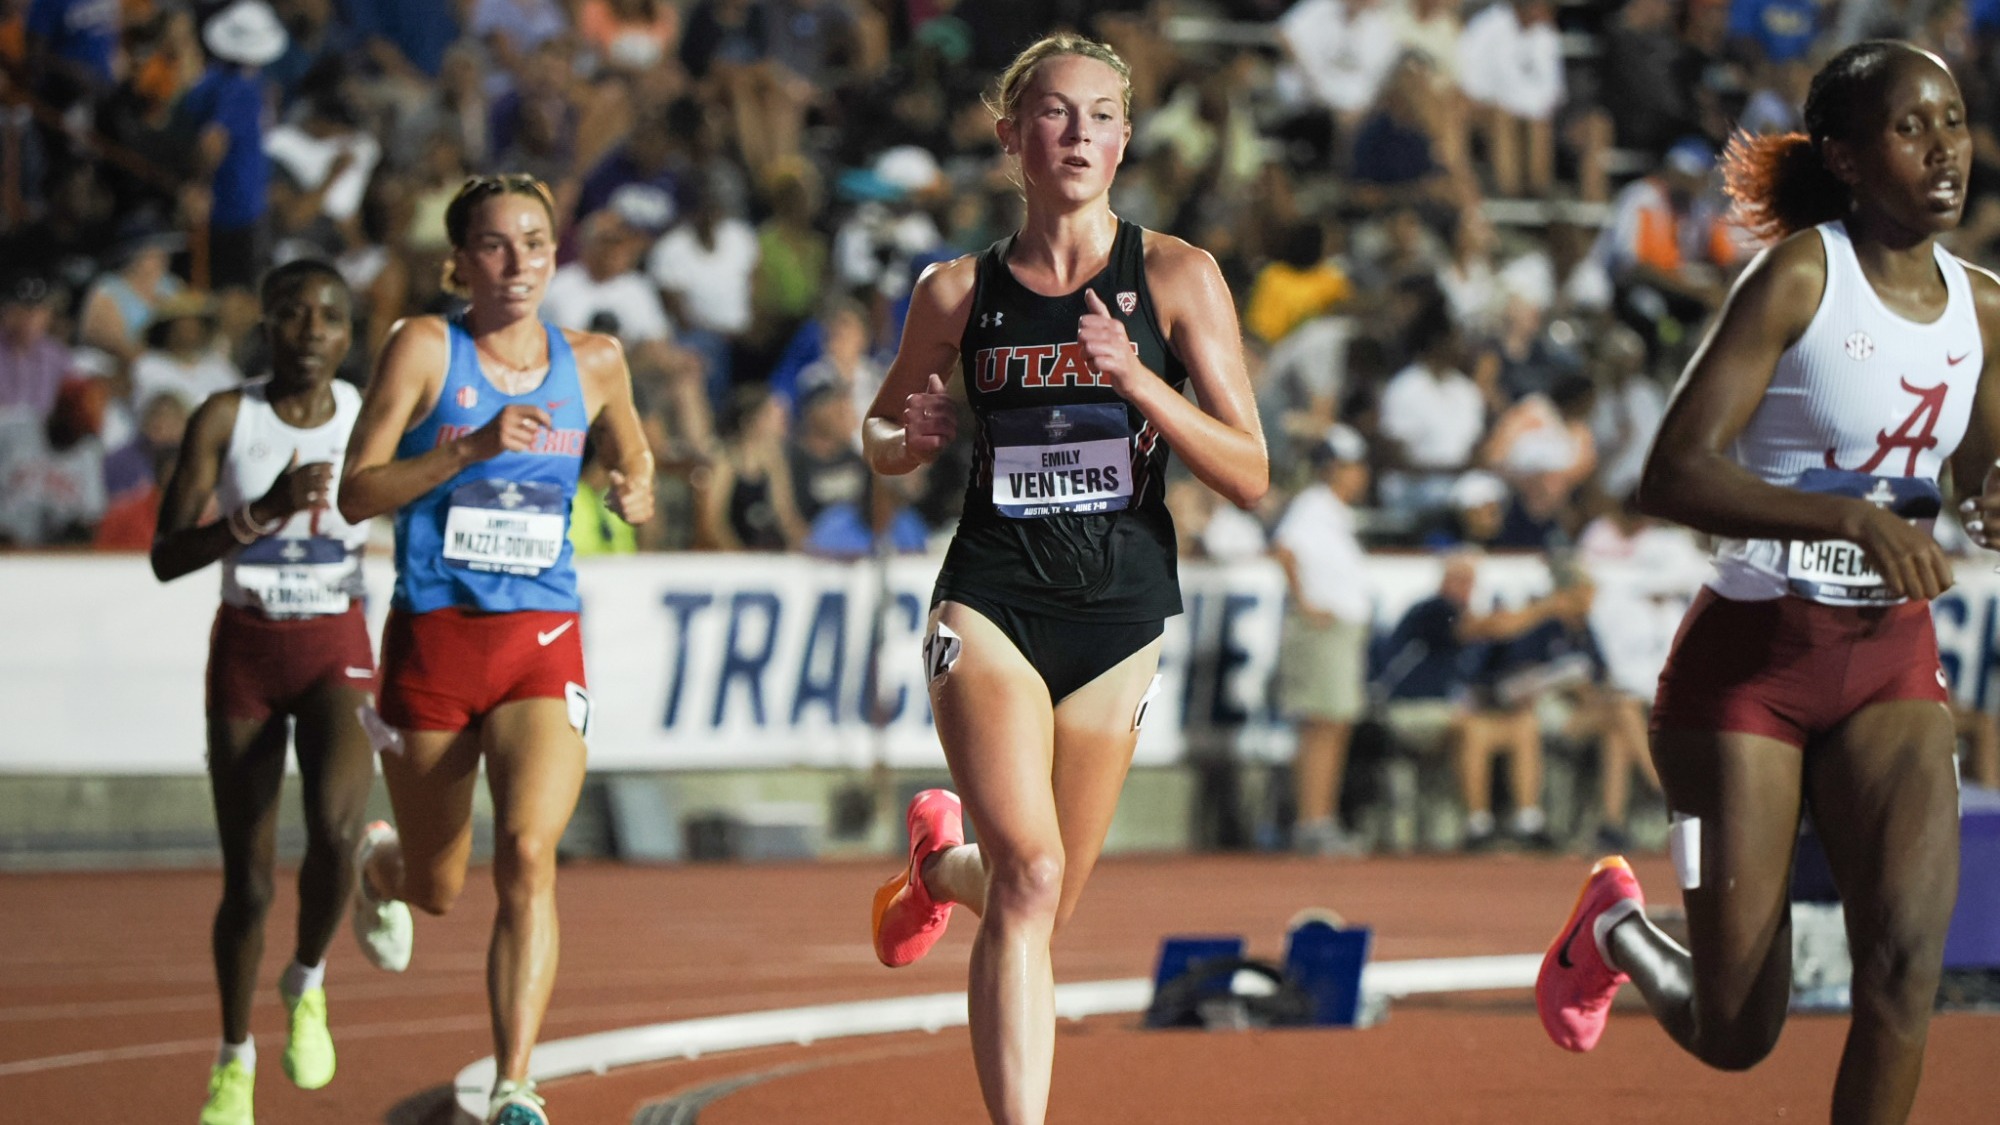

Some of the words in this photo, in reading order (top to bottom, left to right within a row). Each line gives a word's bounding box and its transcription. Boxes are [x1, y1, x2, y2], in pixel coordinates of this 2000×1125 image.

[1121, 302, 1134, 312] 12
[975, 341, 1138, 393] UTA
[1041, 450, 1081, 468] EMILY
[1009, 465, 1120, 499] VENTERS
[1023, 507, 1050, 516] AUSTIN,
[1051, 506, 1061, 514] TX
[1073, 503, 1092, 512] JUNE
[663, 591, 932, 729] TRAC
